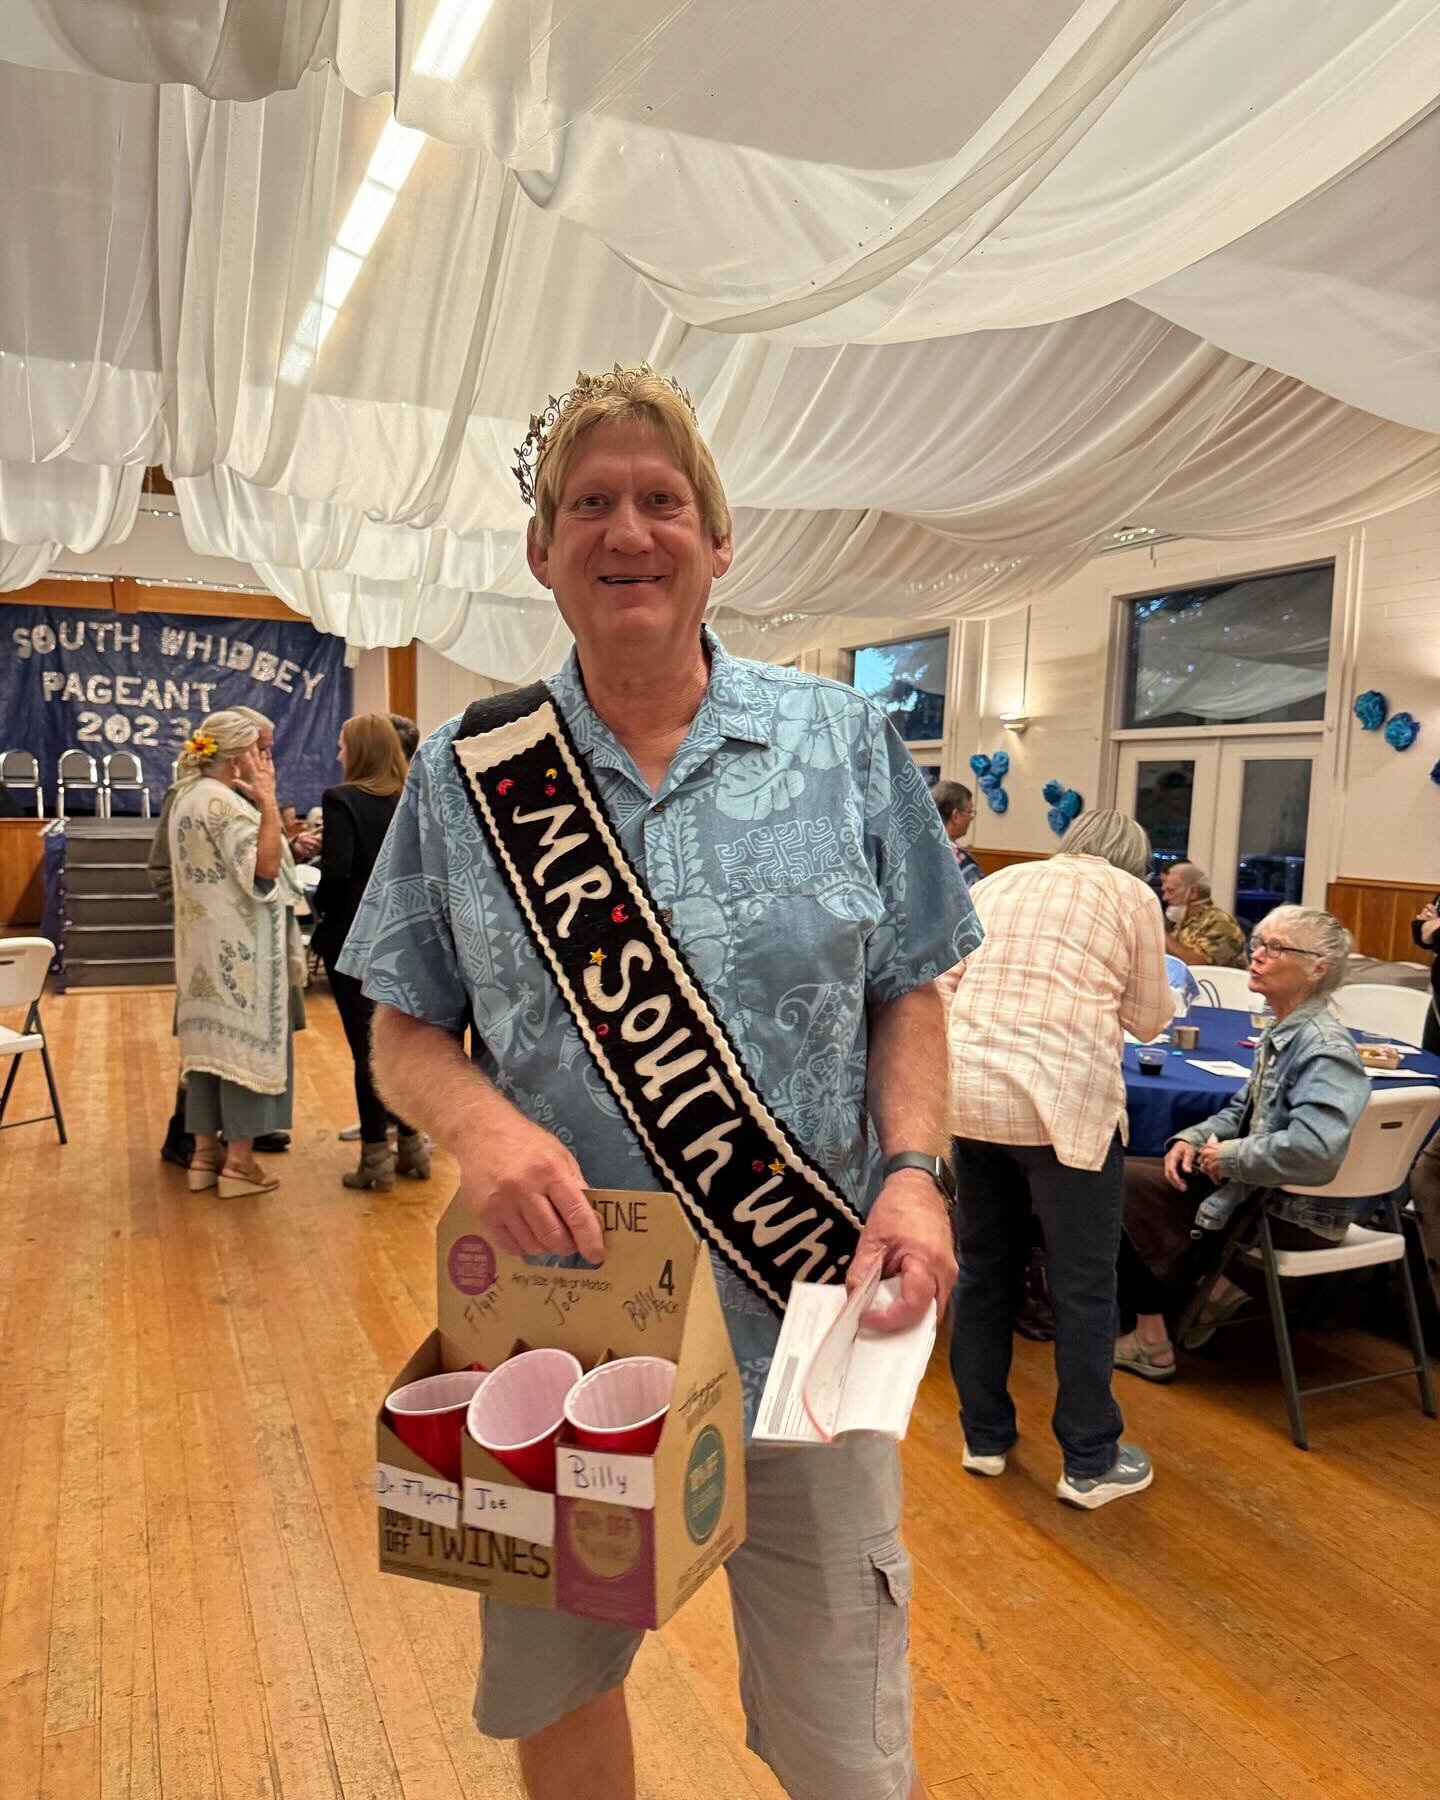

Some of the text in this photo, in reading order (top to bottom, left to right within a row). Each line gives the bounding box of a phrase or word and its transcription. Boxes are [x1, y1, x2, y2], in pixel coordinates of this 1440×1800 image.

[12, 621, 325, 701] SOUTH WHIDBEY
[42, 671, 217, 713] PAGEANT
[76, 711, 192, 748] 2023
[512, 803, 613, 940] MR
[658, 1259, 675, 1296] 4
[567, 1454, 628, 1495] Billy
[473, 1487, 509, 1511] Joe
[440, 1526, 552, 1580] WINES
